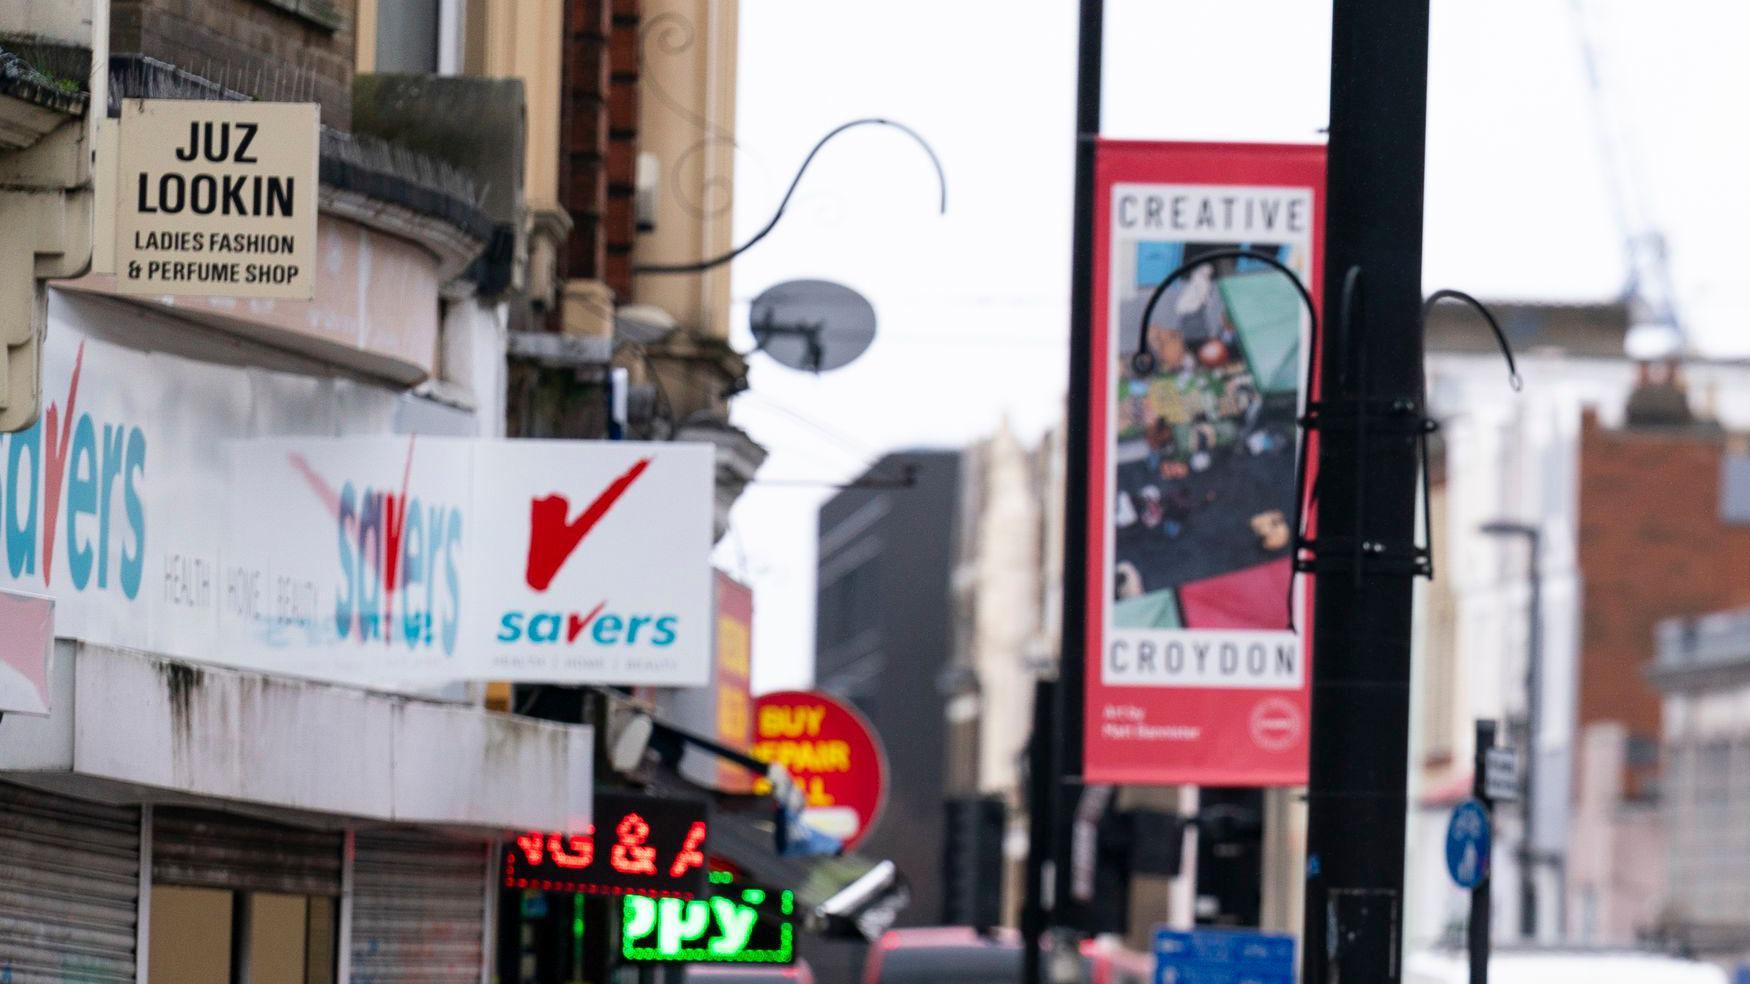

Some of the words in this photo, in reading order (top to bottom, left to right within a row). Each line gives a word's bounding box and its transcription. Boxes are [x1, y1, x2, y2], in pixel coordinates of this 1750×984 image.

[176, 121, 258, 163] JUZ
[138, 172, 294, 217] LOOKIN
[1117, 195, 1306, 232] CREATIVE
[135, 231, 204, 251] LADIES
[209, 232, 294, 254] FASHION
[128, 260, 141, 279] &
[148, 261, 240, 283] PERFUME
[245, 264, 299, 284] SHOP
[0, 337, 147, 601] avers
[336, 432, 463, 657] savers
[496, 600, 679, 646] savers
[1109, 639, 1296, 677] CROYDON
[759, 704, 826, 738] BUY
[752, 739, 850, 773] EPAIR
[611, 812, 657, 876] &
